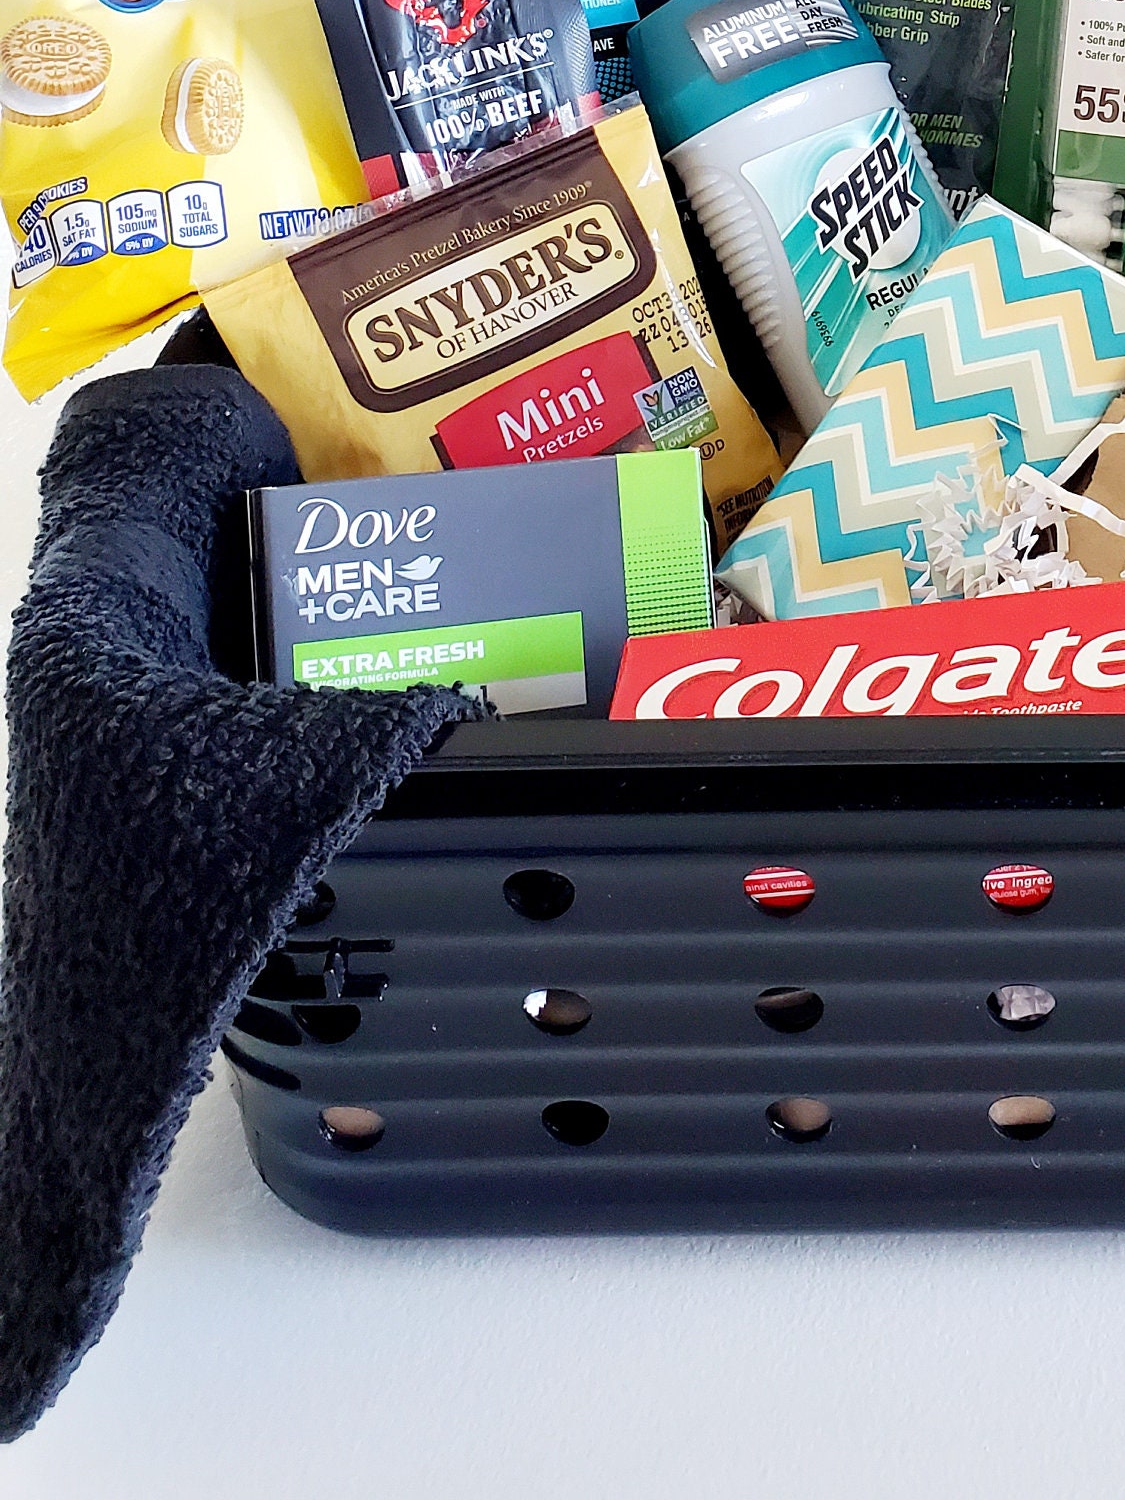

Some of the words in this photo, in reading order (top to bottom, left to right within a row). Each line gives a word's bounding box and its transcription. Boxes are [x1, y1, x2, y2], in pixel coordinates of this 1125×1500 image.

[702, 0, 787, 43] ALUMINUM
[800, 7, 823, 21] DAY
[807, 16, 844, 33] FRESH
[929, 10, 960, 28] Strip
[1088, 19, 1115, 32] 100%
[709, 15, 800, 68] FREE
[900, 27, 929, 45] Grip
[1086, 34, 1106, 46] Soft
[1108, 38, 1125, 48] and
[385, 56, 460, 102] JACK
[454, 32, 549, 78] LINK'S
[1085, 49, 1110, 62] Safer
[1112, 52, 1125, 63] for
[452, 93, 479, 111] MADE
[478, 85, 506, 102] WITH
[1073, 84, 1121, 124] 55
[425, 106, 486, 148] 100%
[486, 89, 543, 128] BEEF
[930, 113, 964, 129] MEN
[811, 138, 899, 247] SPEED
[118, 218, 158, 234] SODIUM
[182, 209, 213, 225] TOTAL
[261, 212, 290, 239] NET
[844, 171, 921, 274] STICK
[62, 232, 77, 247] SAT
[79, 227, 97, 240] FAT
[142, 237, 155, 248] DV
[179, 222, 219, 239] SUGARS
[81, 246, 94, 258] DV
[342, 262, 411, 305] America's
[411, 232, 462, 268] Pretzel
[462, 214, 512, 245] Bakery
[512, 199, 551, 223] Since
[553, 184, 587, 208] 1909
[14, 248, 53, 273] CALORIES
[364, 217, 613, 363] SNYDER'S
[436, 329, 470, 359] OF
[471, 282, 580, 346] HANOVER
[668, 369, 695, 388] NON
[672, 378, 699, 397] GMO
[496, 367, 606, 451] Mini
[651, 395, 706, 430] VERIFIED
[522, 414, 605, 463] Pretzels
[661, 429, 688, 450] Low
[294, 498, 437, 554] Dove
[298, 558, 394, 596] MEN
[298, 582, 441, 624] +CARE
[302, 651, 394, 679] EXTRA
[398, 639, 485, 668] FRESH
[384, 667, 439, 682] FORMULA
